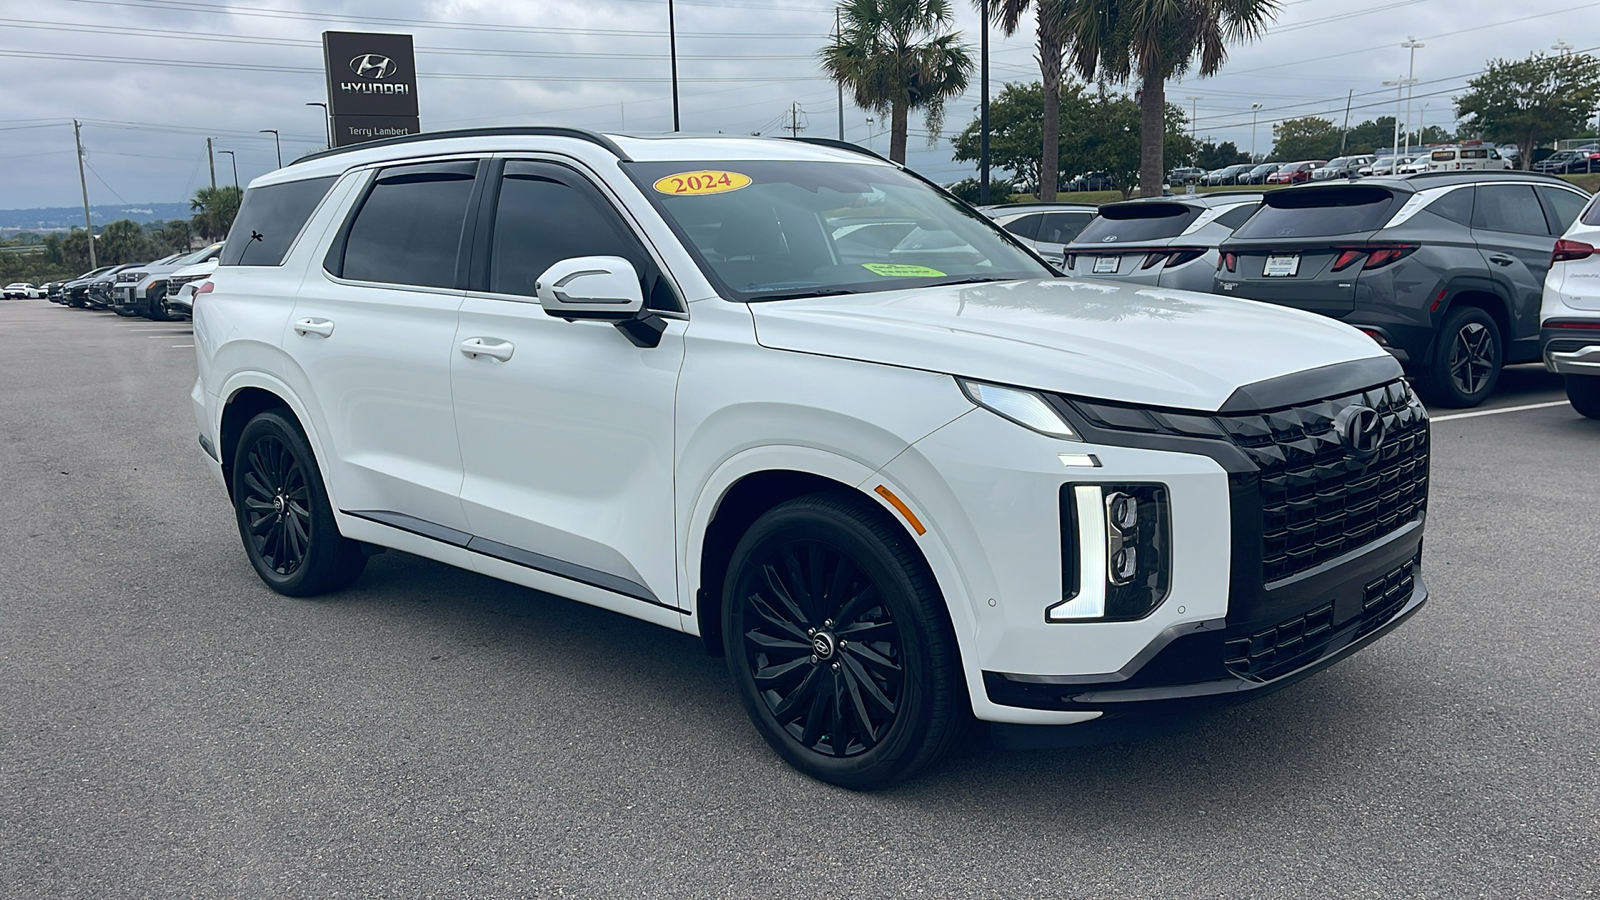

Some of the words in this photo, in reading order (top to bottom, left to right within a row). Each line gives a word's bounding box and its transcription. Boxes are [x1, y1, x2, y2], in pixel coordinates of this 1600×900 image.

[341, 82, 408, 94] HYUNDAI
[349, 127, 372, 137] Terry
[374, 127, 408, 135] Lambert
[671, 173, 731, 193] 2024
